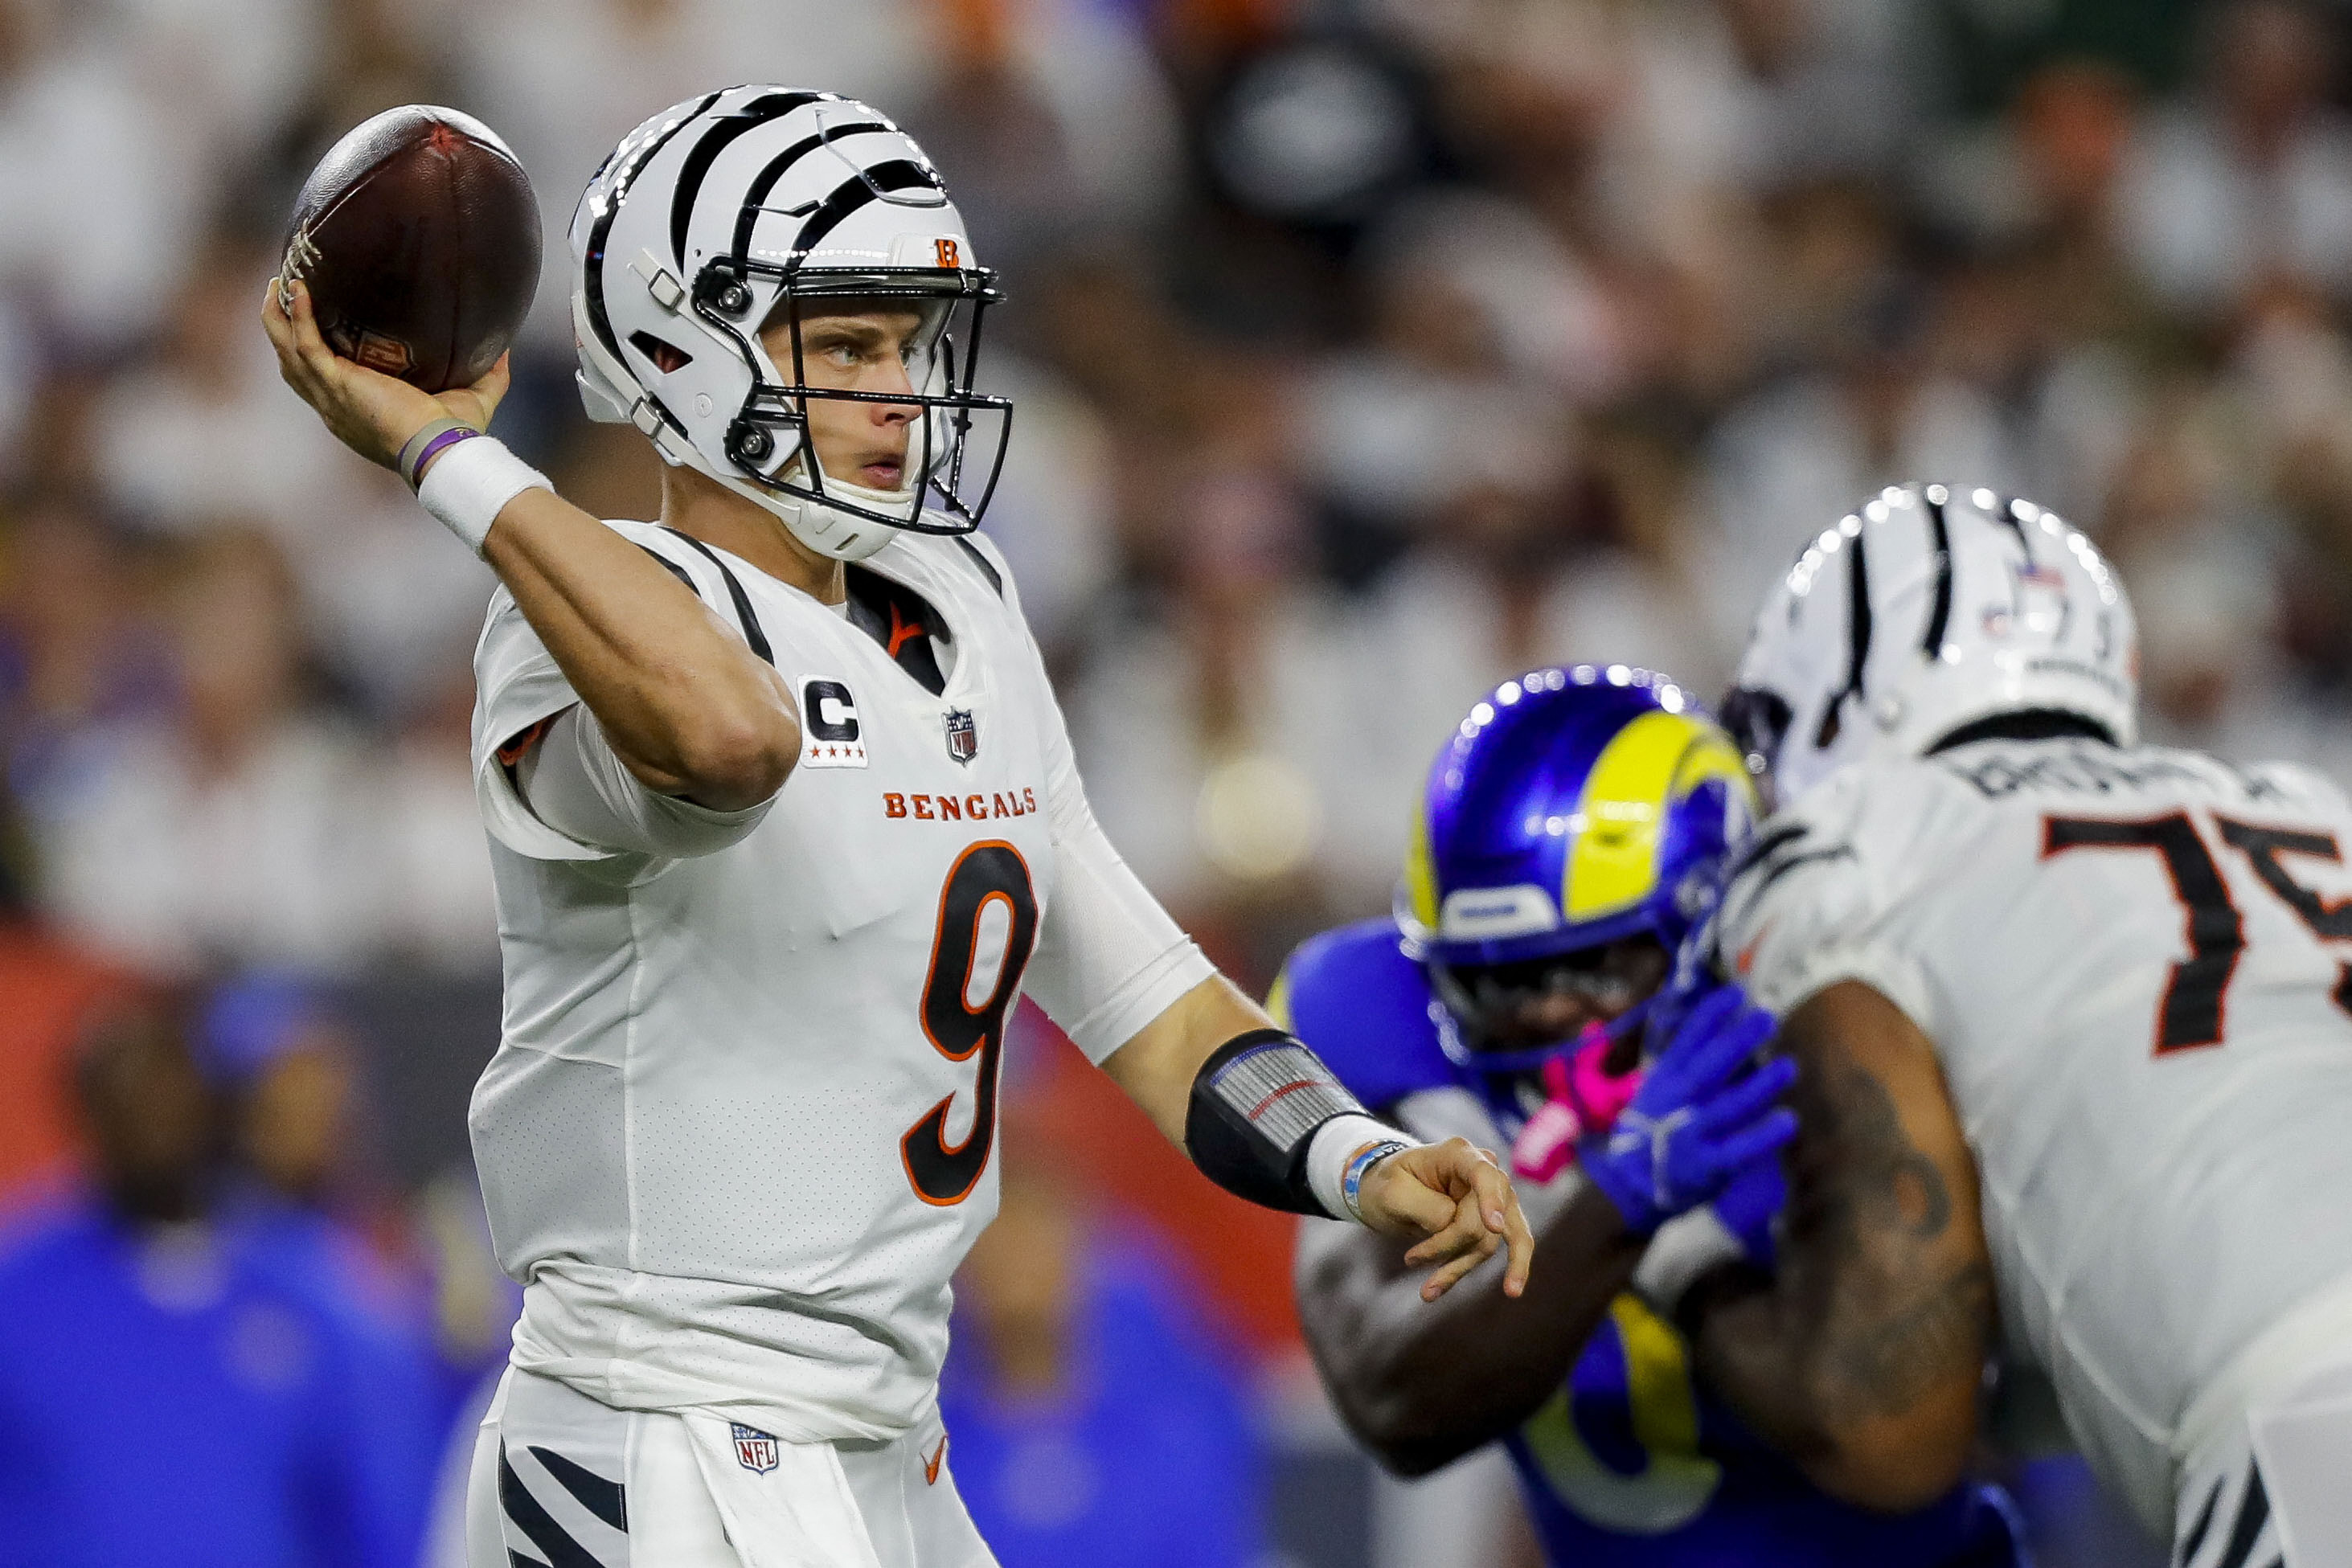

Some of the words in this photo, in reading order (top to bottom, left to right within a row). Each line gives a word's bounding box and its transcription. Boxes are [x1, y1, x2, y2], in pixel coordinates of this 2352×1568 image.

[934, 239, 959, 268] B
[805, 680, 859, 742] C
[883, 787, 1036, 821] BENGALS
[2040, 806, 2352, 1058] 75
[899, 838, 1039, 1206] 9
[737, 1440, 775, 1468] NFL
